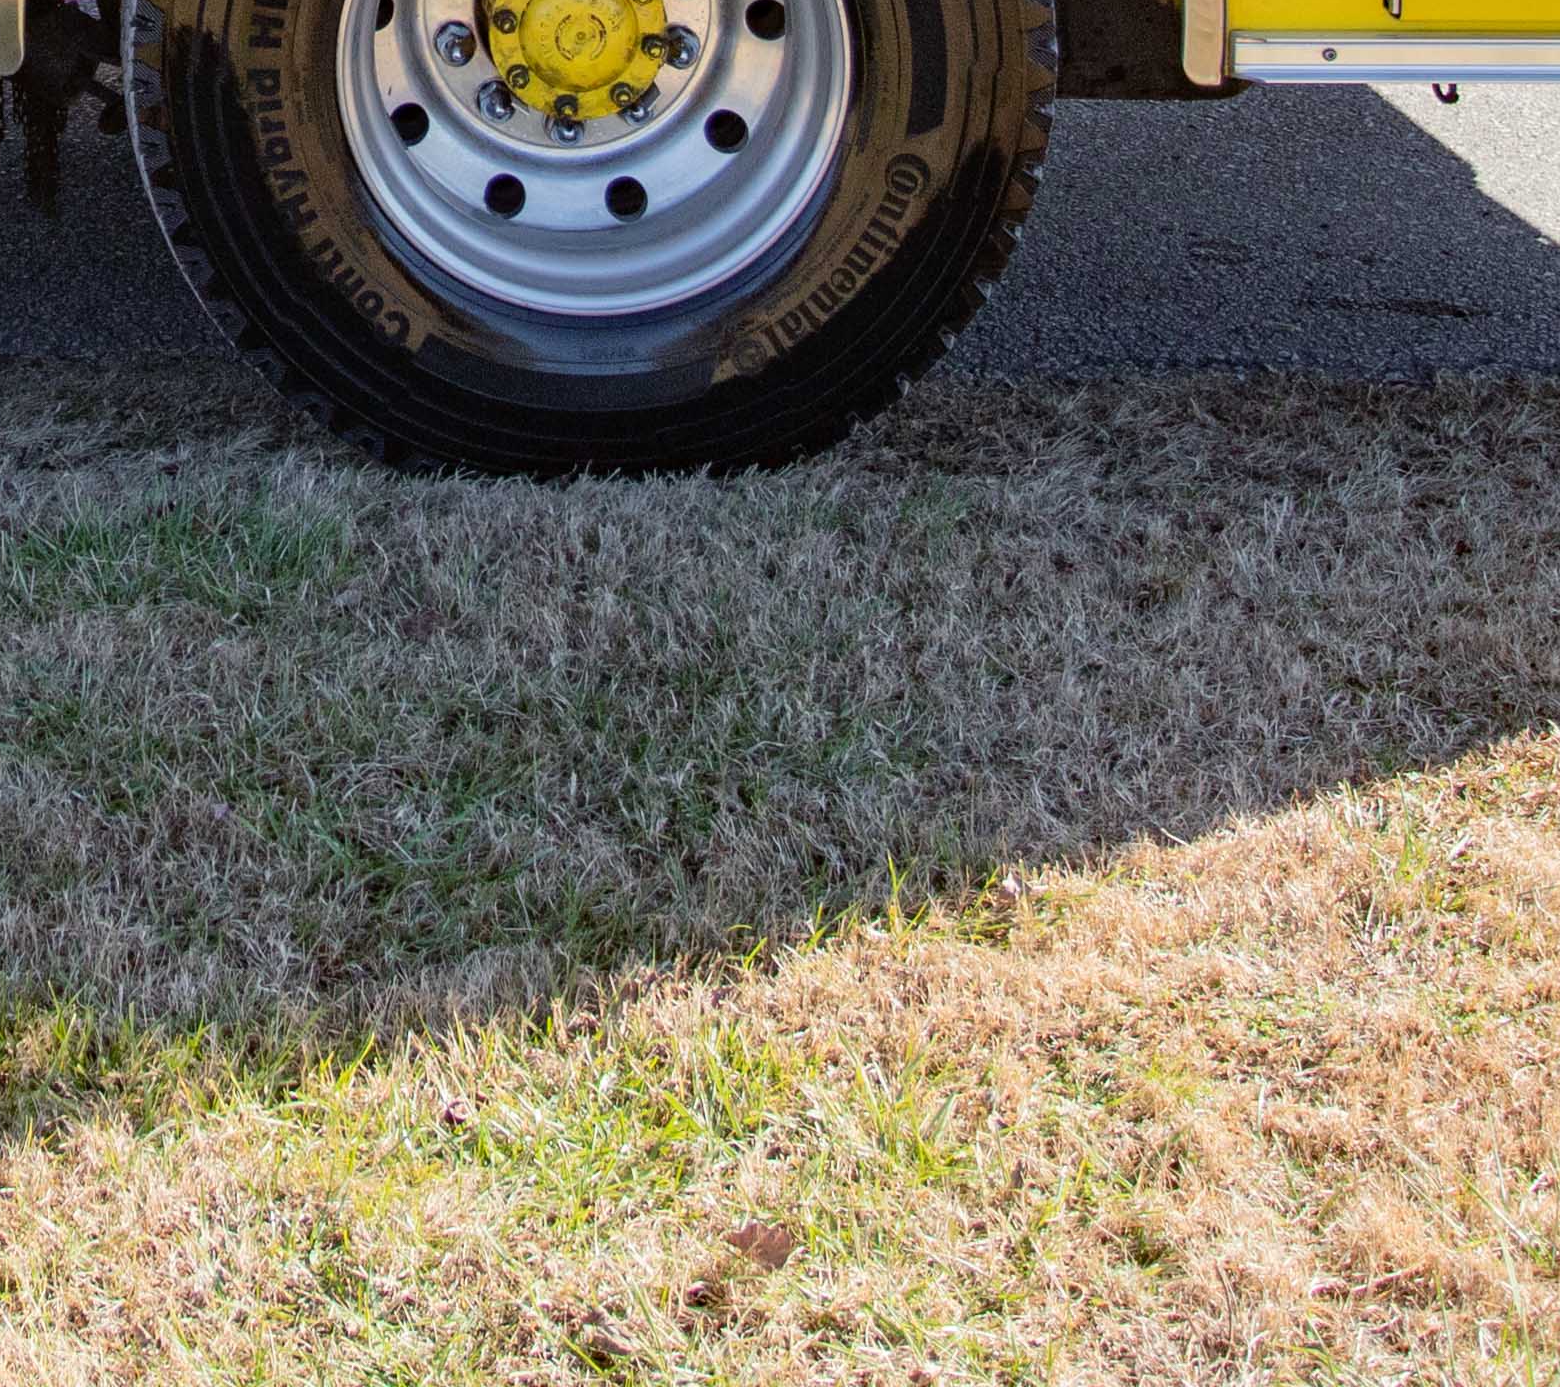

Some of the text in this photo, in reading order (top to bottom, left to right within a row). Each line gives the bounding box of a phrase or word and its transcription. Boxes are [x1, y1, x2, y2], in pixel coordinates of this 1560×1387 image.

[249, 68, 318, 225] Hybrid
[309, 236, 412, 348] Conti
[761, 152, 930, 357] Continental
